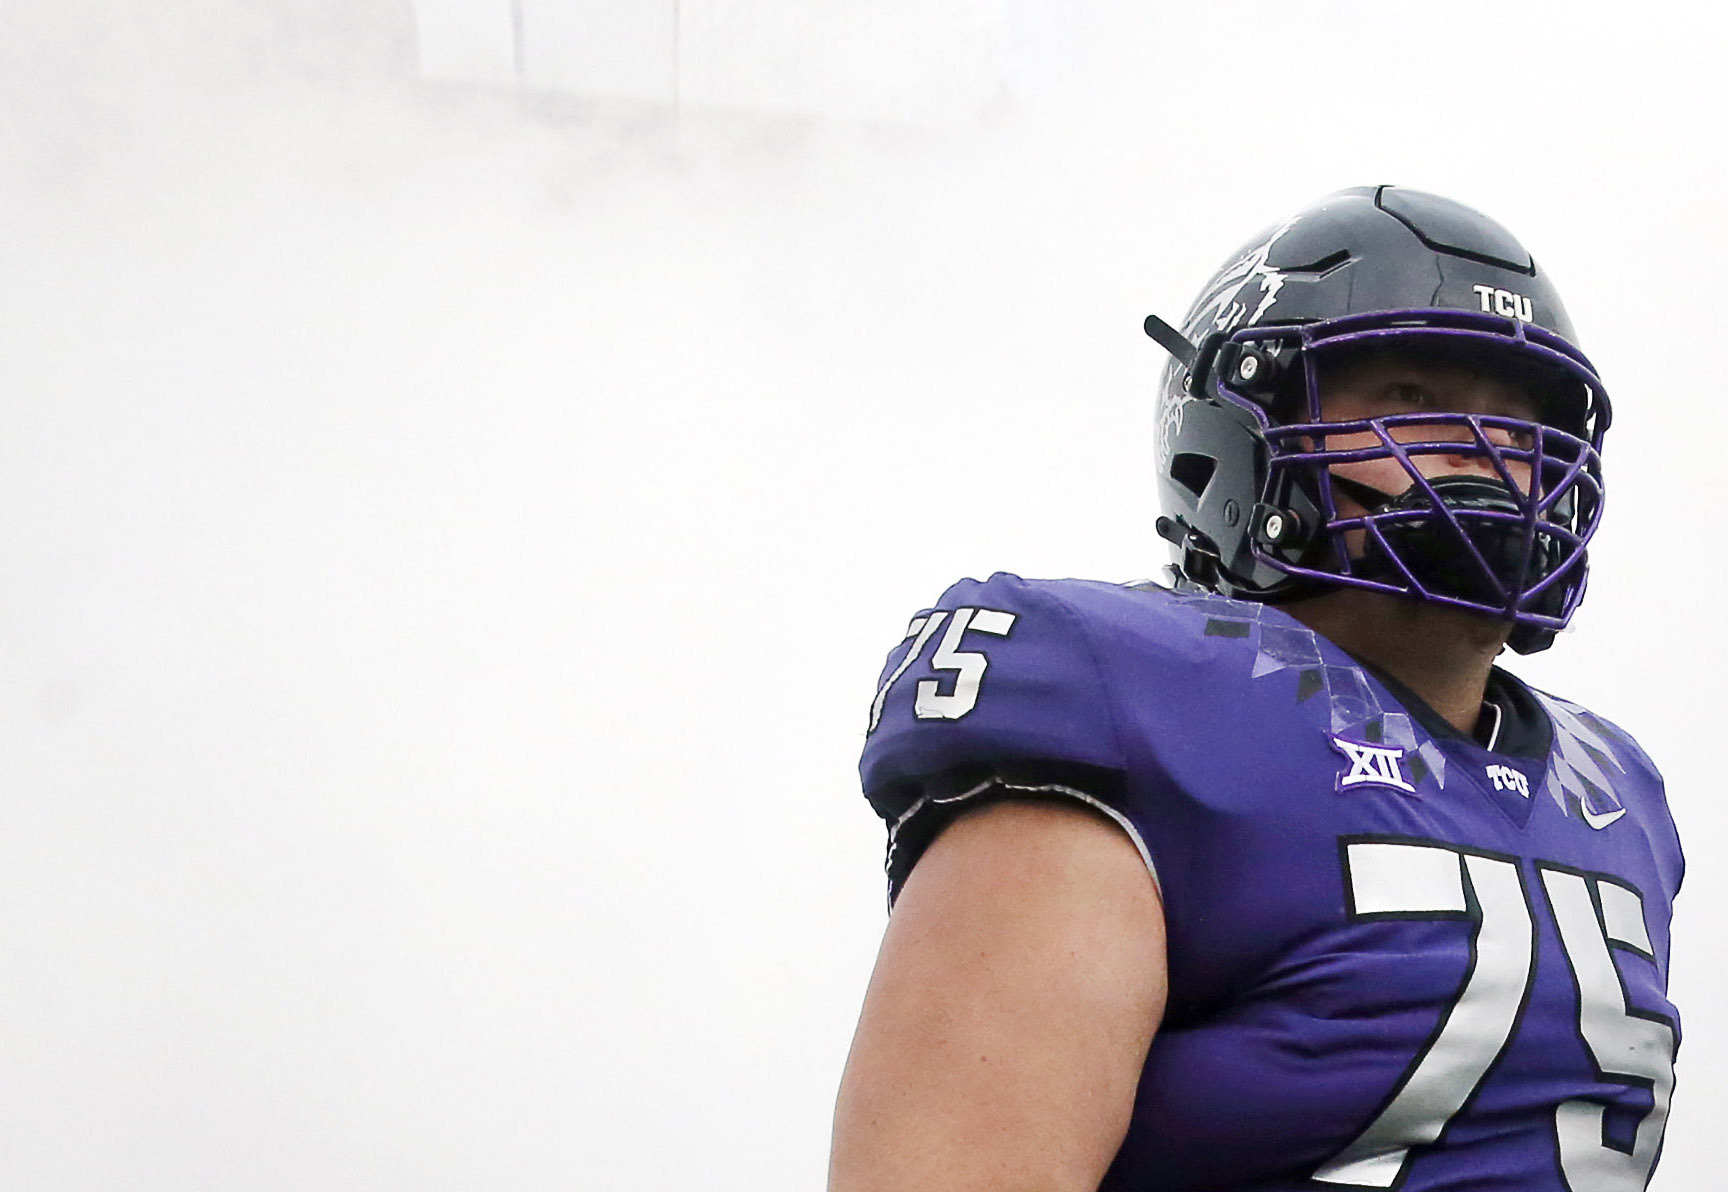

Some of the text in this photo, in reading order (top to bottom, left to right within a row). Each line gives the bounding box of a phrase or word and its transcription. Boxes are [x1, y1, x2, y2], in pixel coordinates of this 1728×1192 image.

[1472, 284, 1533, 323] TCU
[868, 607, 1017, 731] 75
[1333, 737, 1416, 793] XII
[1485, 764, 1530, 799] TCU
